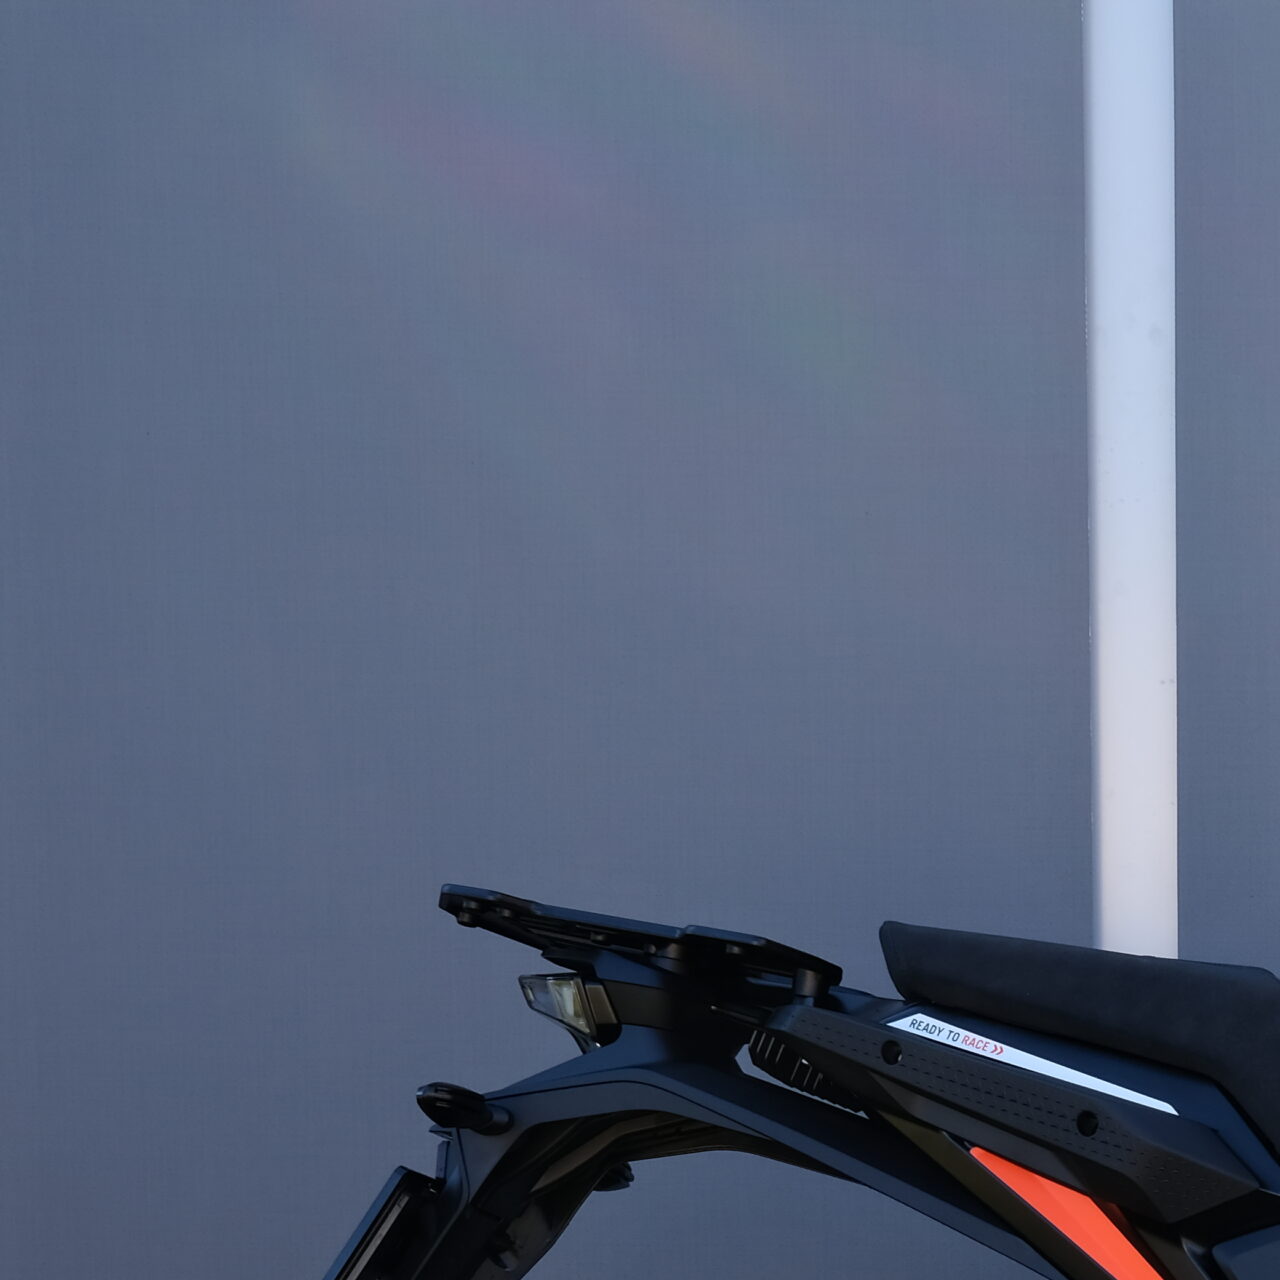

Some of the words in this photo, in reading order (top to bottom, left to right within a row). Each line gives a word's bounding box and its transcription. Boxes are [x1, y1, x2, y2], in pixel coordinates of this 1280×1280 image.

[909, 1018, 944, 1037] READY
[945, 1029, 960, 1042] TO
[961, 1033, 991, 1052] RACE
